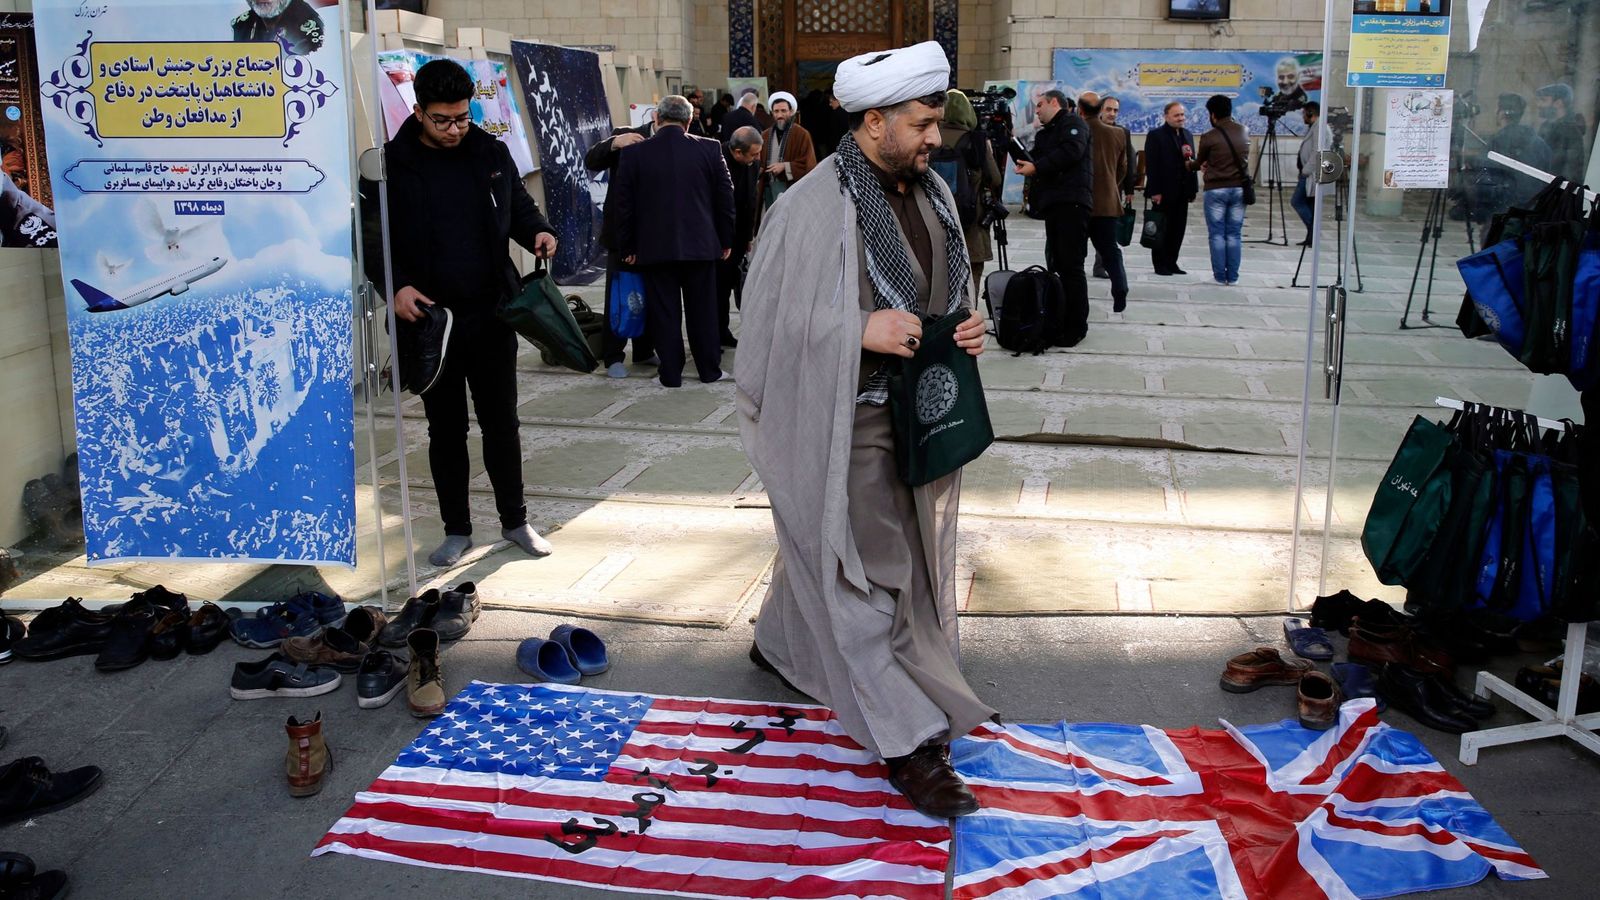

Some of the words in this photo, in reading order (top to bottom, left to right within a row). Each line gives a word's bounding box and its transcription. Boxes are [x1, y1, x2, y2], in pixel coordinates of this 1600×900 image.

[99, 64, 107, 77] و
[109, 56, 154, 76] استادی
[157, 57, 195, 76] جنبش
[198, 56, 232, 77] بزرگ
[235, 56, 280, 76] اجتماع
[104, 81, 135, 103] دفاع
[137, 85, 153, 103] در
[155, 81, 201, 104] پایتخت
[203, 81, 275, 102] دانشگاهیان
[142, 107, 173, 128] وطن
[175, 106, 227, 128] مدافعان
[230, 108, 241, 128] از
[103, 163, 134, 175] سلیمانی
[135, 163, 152, 175] قاسم
[153, 163, 169, 175] حاج
[170, 165, 189, 174] شهید
[190, 163, 210, 175] ایران
[212, 167, 217, 175] و
[217, 163, 238, 175] اسلام
[238, 164, 261, 175] سپهبد
[261, 163, 273, 174] یاد
[274, 165, 282, 174] به
[104, 178, 141, 190] مسافربری
[142, 178, 175, 190] هواپیمای
[177, 182, 181, 190] و
[182, 177, 204, 190] کرمان
[229, 177, 259, 190] باختگان
[259, 178, 275, 190] جان
[277, 182, 282, 190] و
[175, 202, 199, 212] ۱۳۹۸
[201, 202, 222, 213] دیماه
[947, 419, 964, 428] مسجد
[1391, 475, 1411, 492] تهران
[722, 708, 806, 754] مرگ
[687, 757, 734, 788] بر
